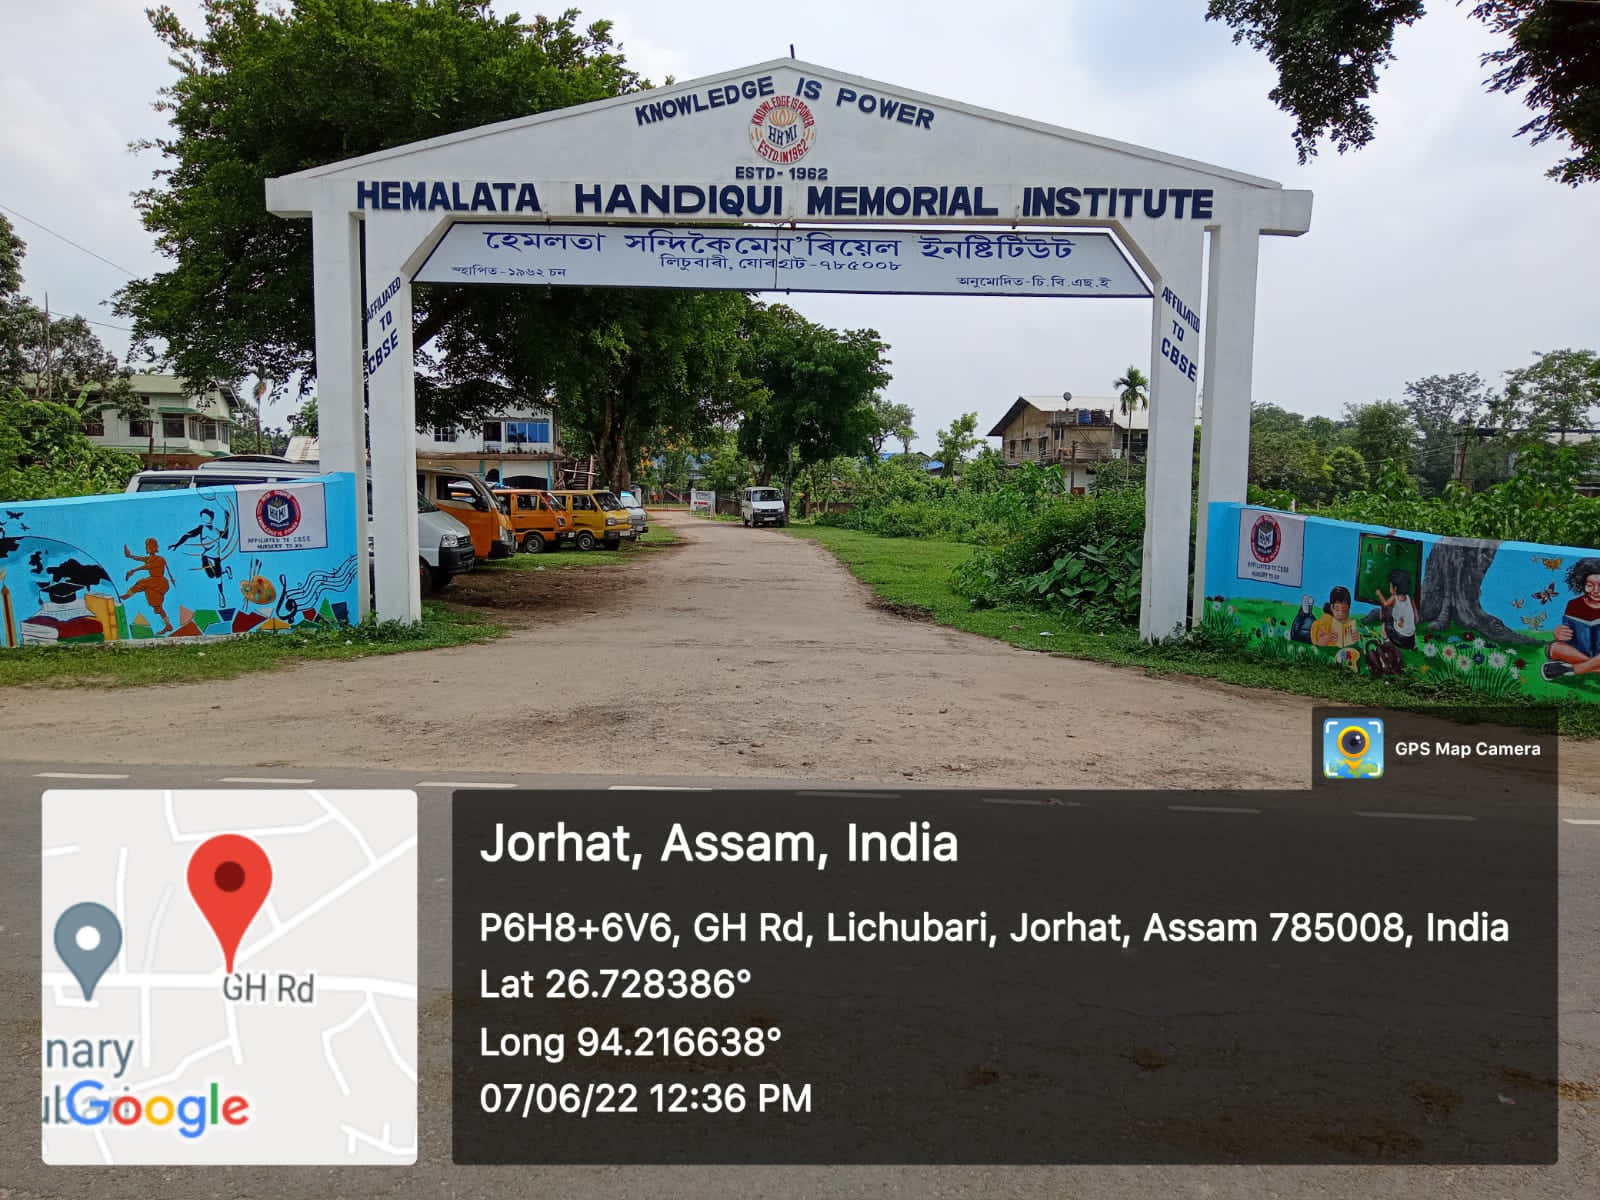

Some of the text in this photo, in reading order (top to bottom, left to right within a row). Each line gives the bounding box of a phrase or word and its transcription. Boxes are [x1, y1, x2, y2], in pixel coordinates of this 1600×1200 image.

[635, 76, 935, 129] KNOWLEDGE IS POWER
[768, 124, 797, 145] HHMI
[789, 167, 829, 181] 1962
[357, 181, 1214, 219] HEMALATA HANDIQUI MEMORIAL INSTITUTE
[482, 232, 606, 252] হেমলতা
[367, 276, 401, 321] AFFILIATED
[1162, 286, 1200, 334] AFFILIATED
[380, 310, 393, 332] TO
[1172, 319, 1185, 342] TO
[367, 328, 399, 375] CBSE
[1161, 337, 1197, 382] CBSE
